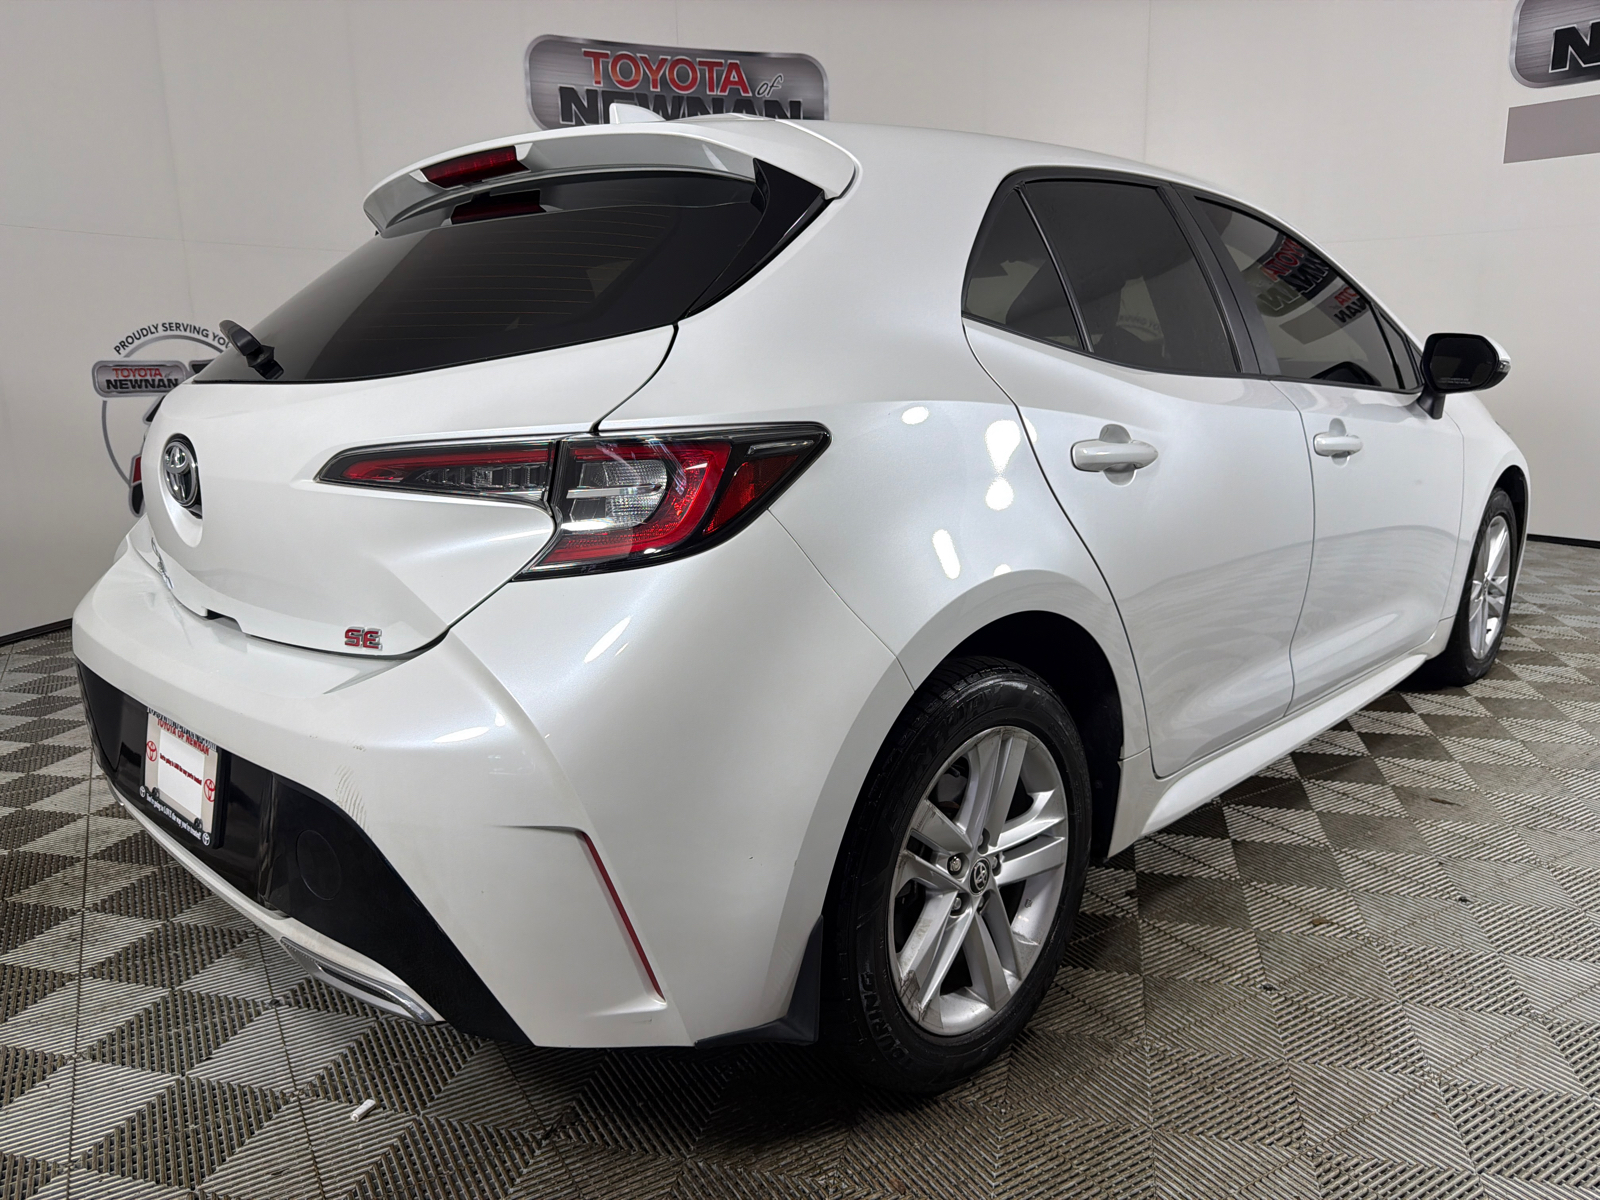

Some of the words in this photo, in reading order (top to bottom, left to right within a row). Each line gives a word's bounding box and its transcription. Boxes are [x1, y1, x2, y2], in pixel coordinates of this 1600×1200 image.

[582, 48, 752, 97] TOYOTA
[756, 74, 784, 98] of
[113, 323, 160, 355] PROUDLY
[161, 321, 209, 338] SERVING
[105, 379, 179, 390] NEWNAN
[112, 367, 162, 378] TOYOTA
[344, 626, 383, 651] SE
